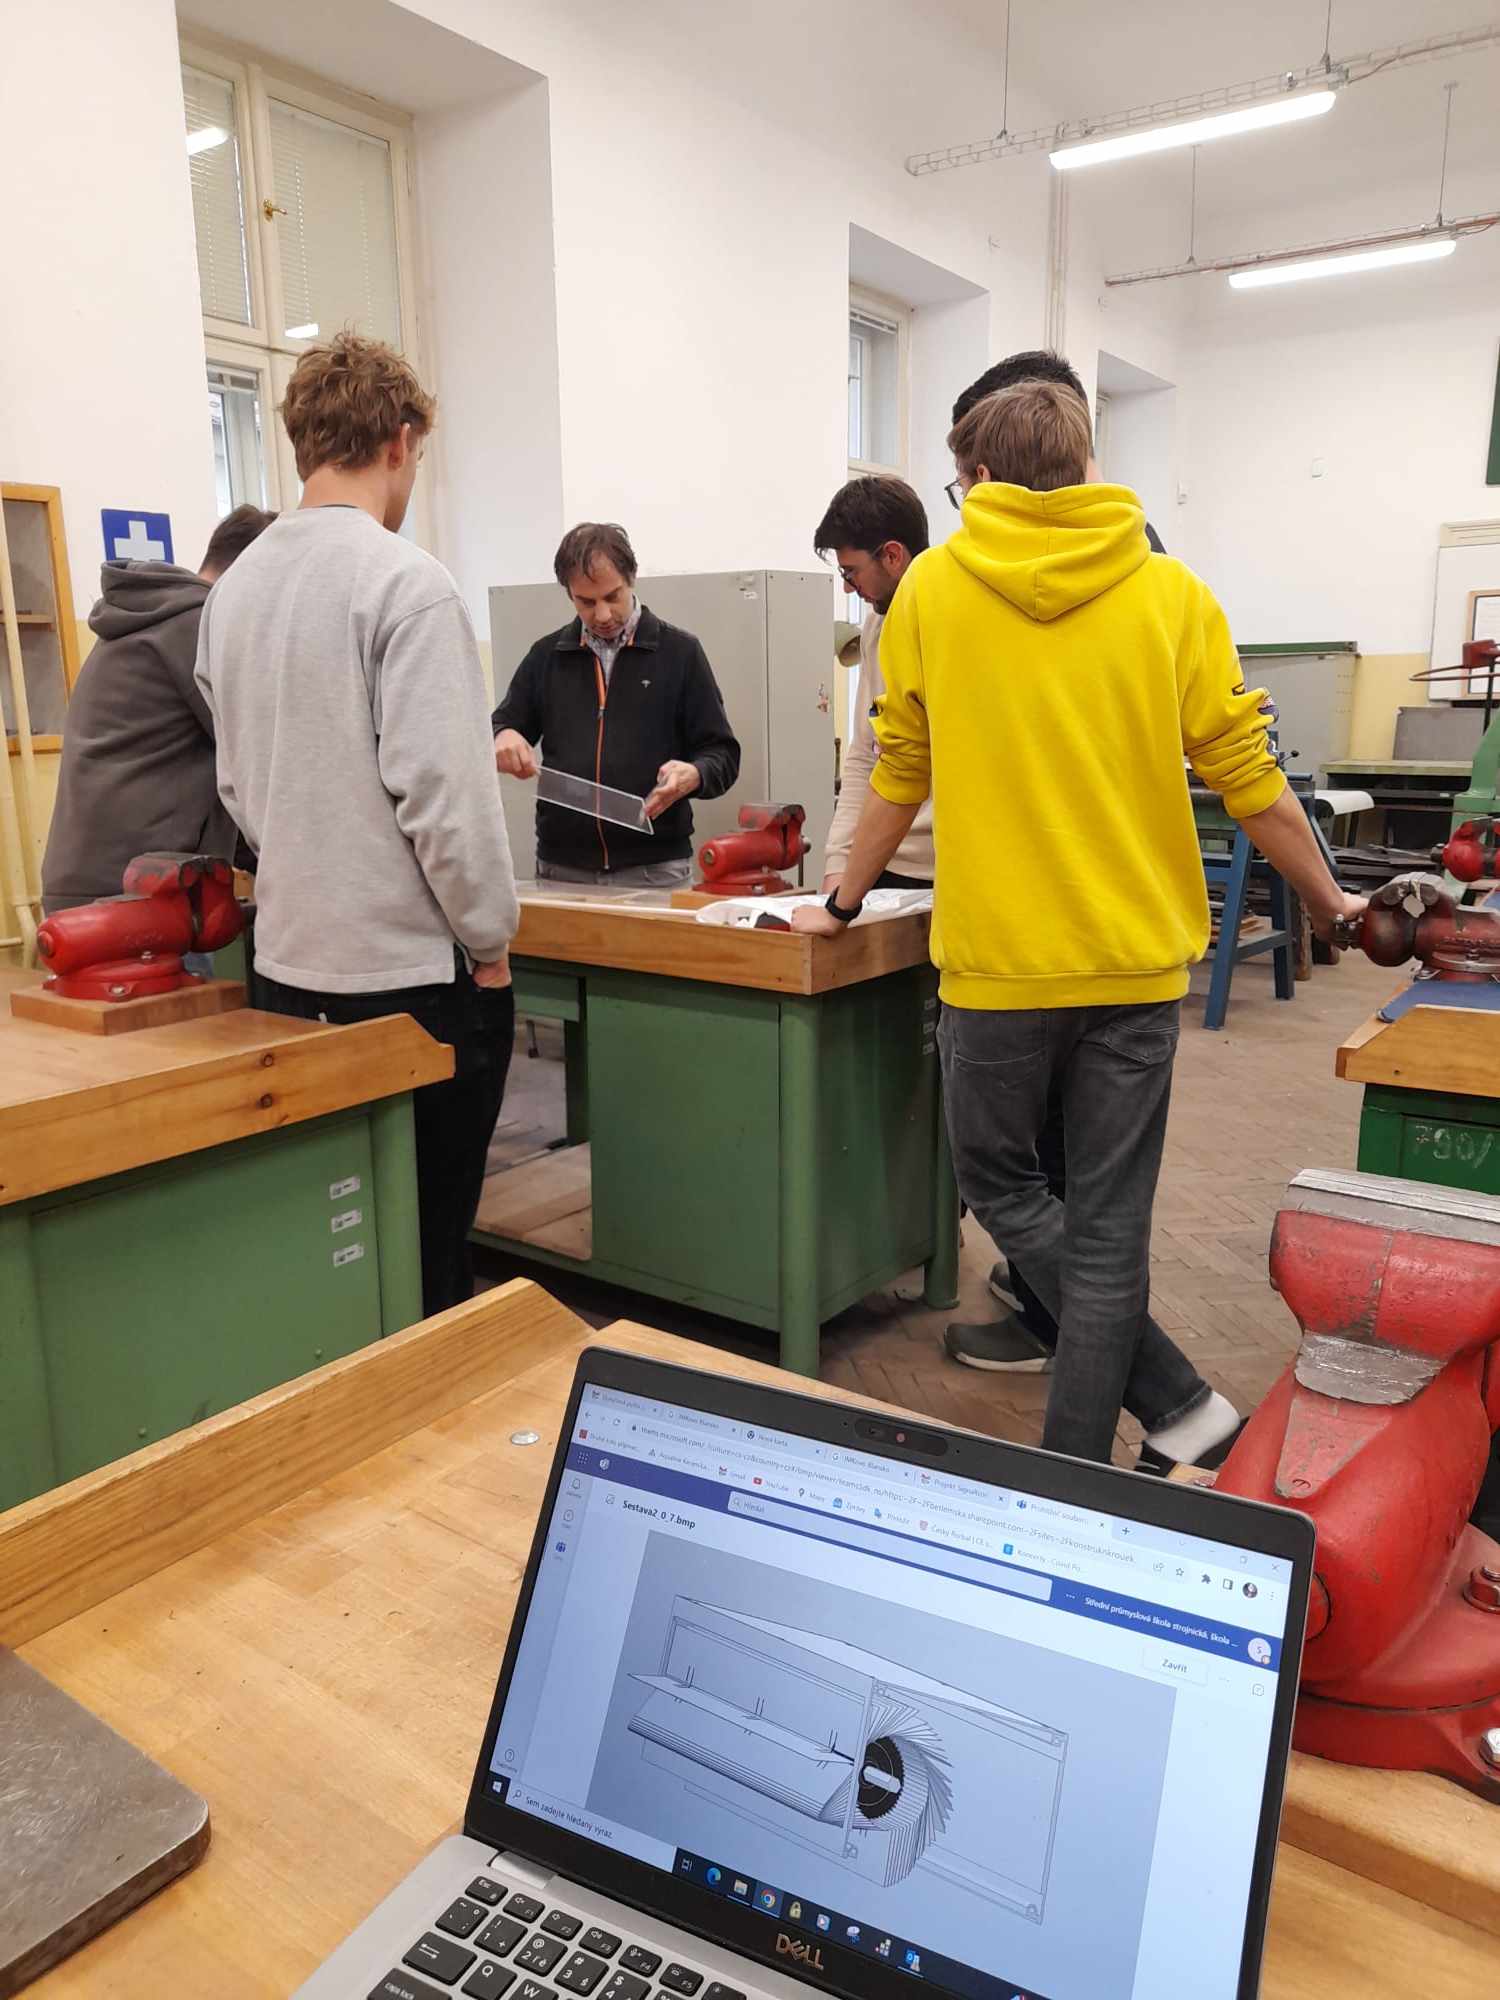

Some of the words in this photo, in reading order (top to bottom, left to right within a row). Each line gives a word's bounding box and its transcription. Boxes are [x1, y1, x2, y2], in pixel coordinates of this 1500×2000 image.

[622, 1500, 696, 1530] Sestava2_0_7.bmp
[1085, 1596, 1111, 1613] Střední
[1110, 1603, 1151, 1623] průmyslová
[1152, 1615, 1171, 1629] škola
[1161, 1658, 1188, 1674] Zavřít
[526, 1796, 540, 1809] Sem
[540, 1804, 565, 1819] zadejte
[478, 1878, 491, 1889] Esc
[775, 1933, 825, 1971] DELL
[481, 1965, 494, 1978] Q
[523, 1984, 541, 1999] W
